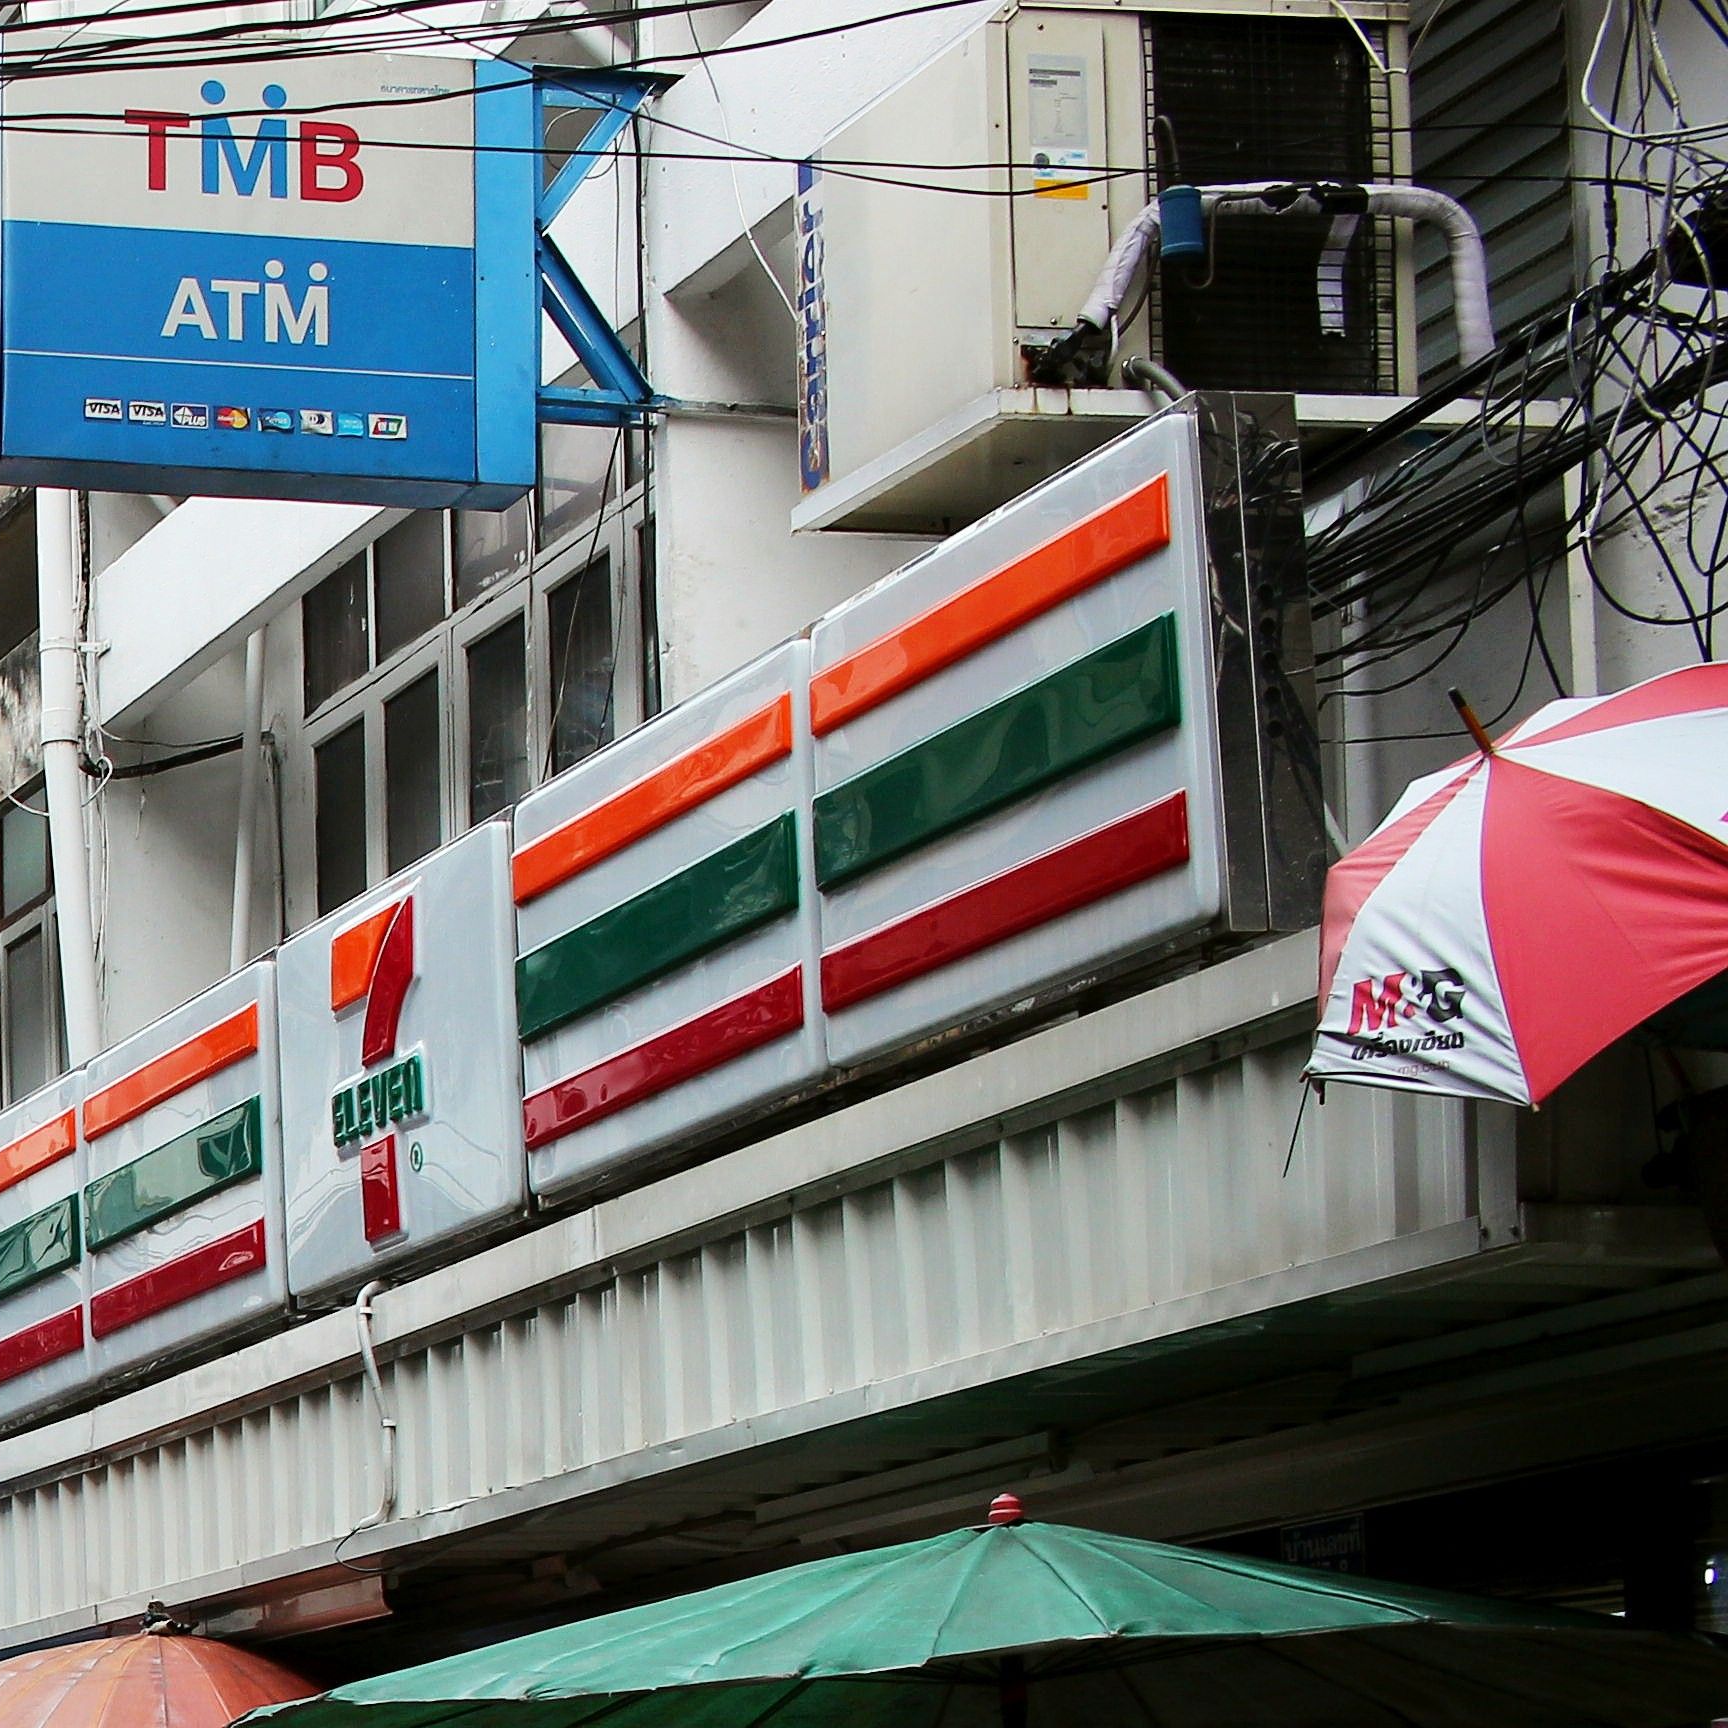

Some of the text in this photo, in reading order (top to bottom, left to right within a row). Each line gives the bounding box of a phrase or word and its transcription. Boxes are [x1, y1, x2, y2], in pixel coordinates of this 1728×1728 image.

[125, 82, 363, 202] TMB
[160, 261, 329, 346] ATM
[88, 401, 121, 415] VISA
[132, 403, 164, 417] VISA
[183, 414, 206, 427] PLUS
[331, 895, 414, 1243] 7
